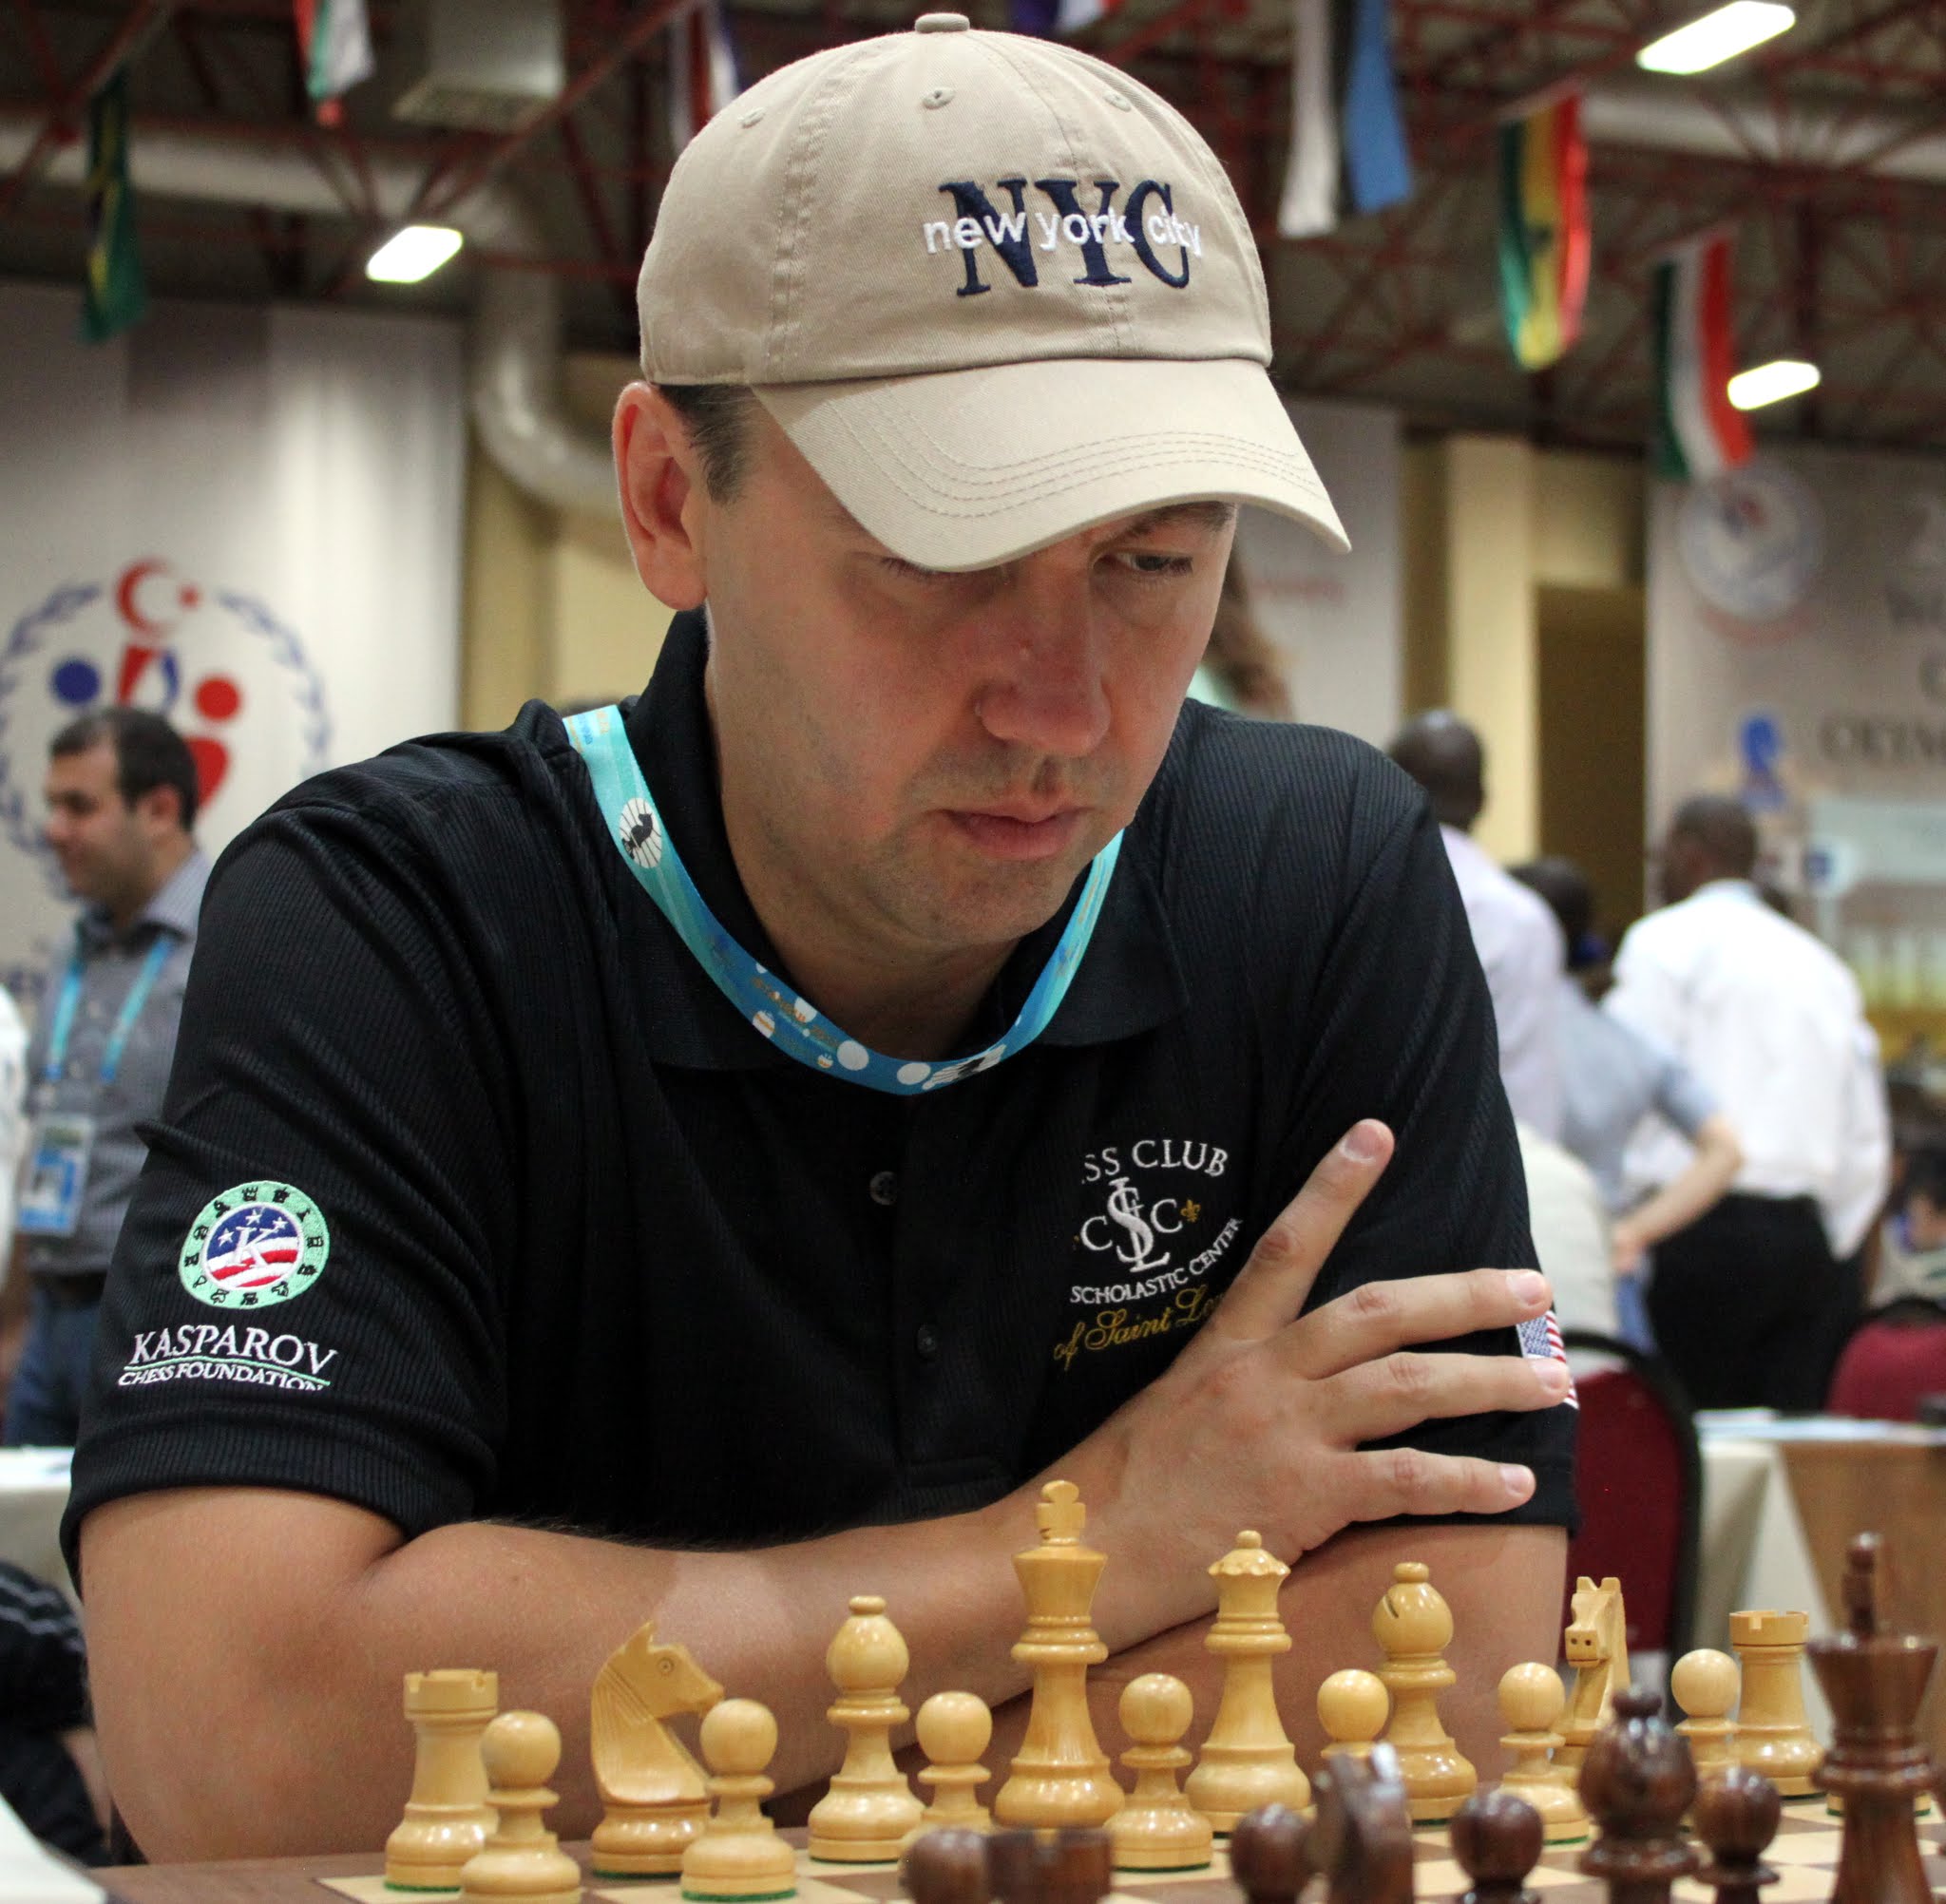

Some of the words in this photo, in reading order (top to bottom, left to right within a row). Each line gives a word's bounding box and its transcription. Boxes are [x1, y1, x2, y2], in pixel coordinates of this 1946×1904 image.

[923, 212, 1026, 255] new
[1035, 206, 1135, 252] york
[1147, 204, 1203, 259] city
[939, 177, 1190, 296] NYC
[1132, 1139, 1229, 1177] CLUB
[224, 1226, 279, 1269] K
[1070, 1267, 1189, 1304] SCHOLASTIC
[1189, 1217, 1244, 1276] CENTER
[129, 1324, 339, 1376] KASPAROV
[1054, 1322, 1085, 1372] of
[1084, 1306, 1174, 1350] Saint
[118, 1362, 176, 1387] CHESS
[175, 1361, 325, 1392] FOUNDATION
